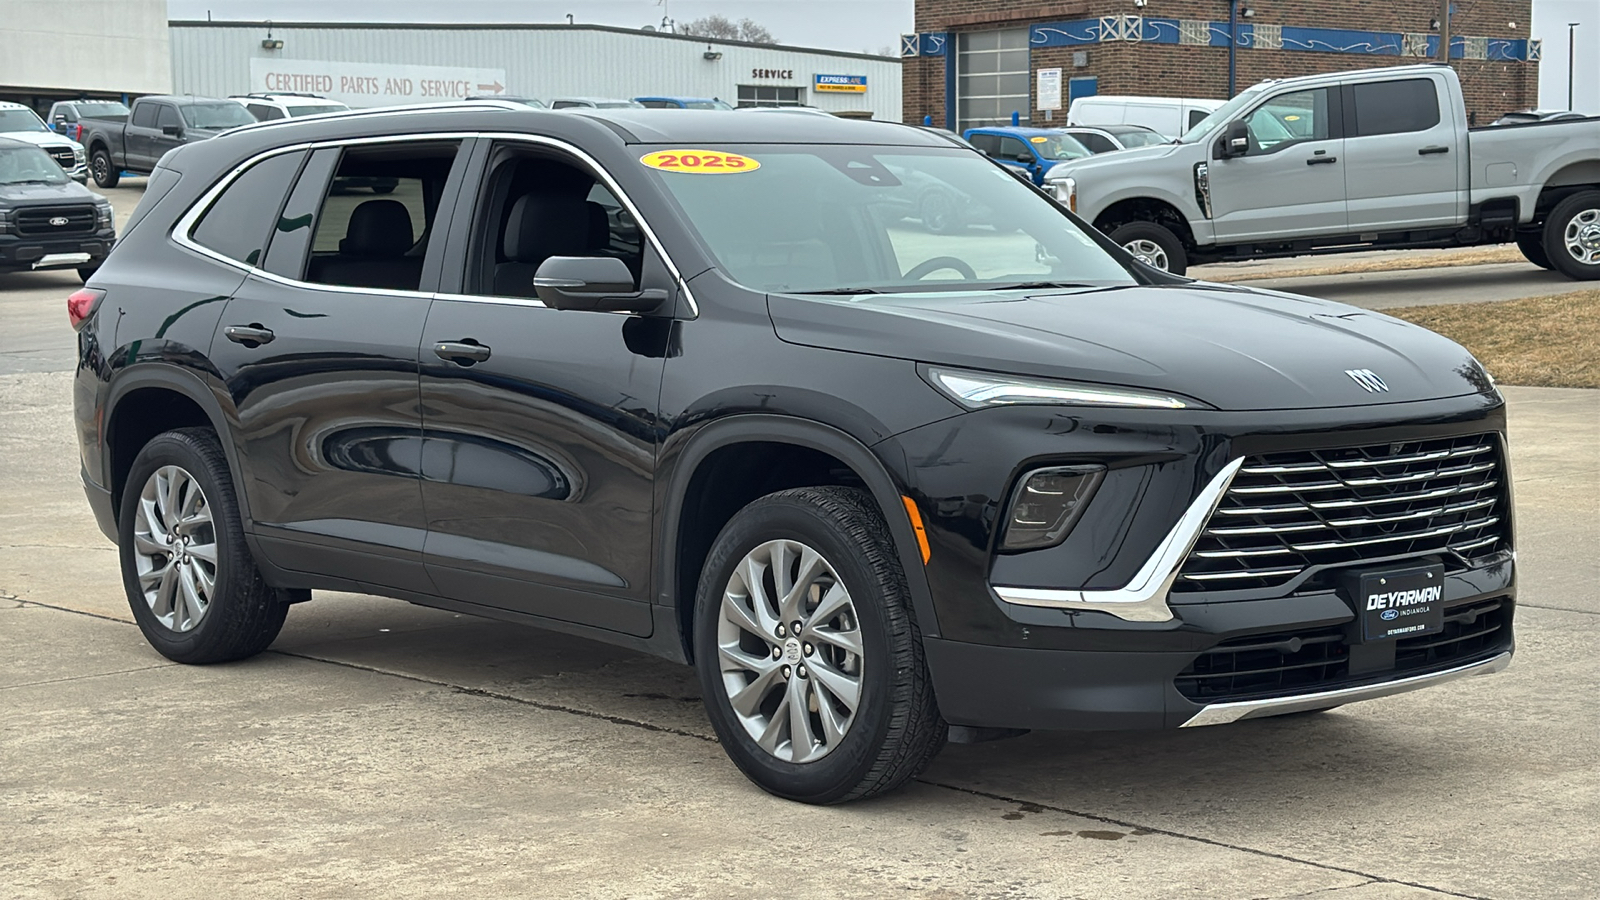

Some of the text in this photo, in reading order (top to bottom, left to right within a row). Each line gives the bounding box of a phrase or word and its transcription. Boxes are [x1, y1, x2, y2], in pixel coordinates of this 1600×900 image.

[752, 69, 793, 79] SERVICE
[266, 72, 471, 98] CERTIFIED PARTS AND SERVICE
[657, 155, 746, 168] 2025
[1366, 585, 1442, 611] DEYARMAN
[1400, 606, 1430, 616] INDIANOLA
